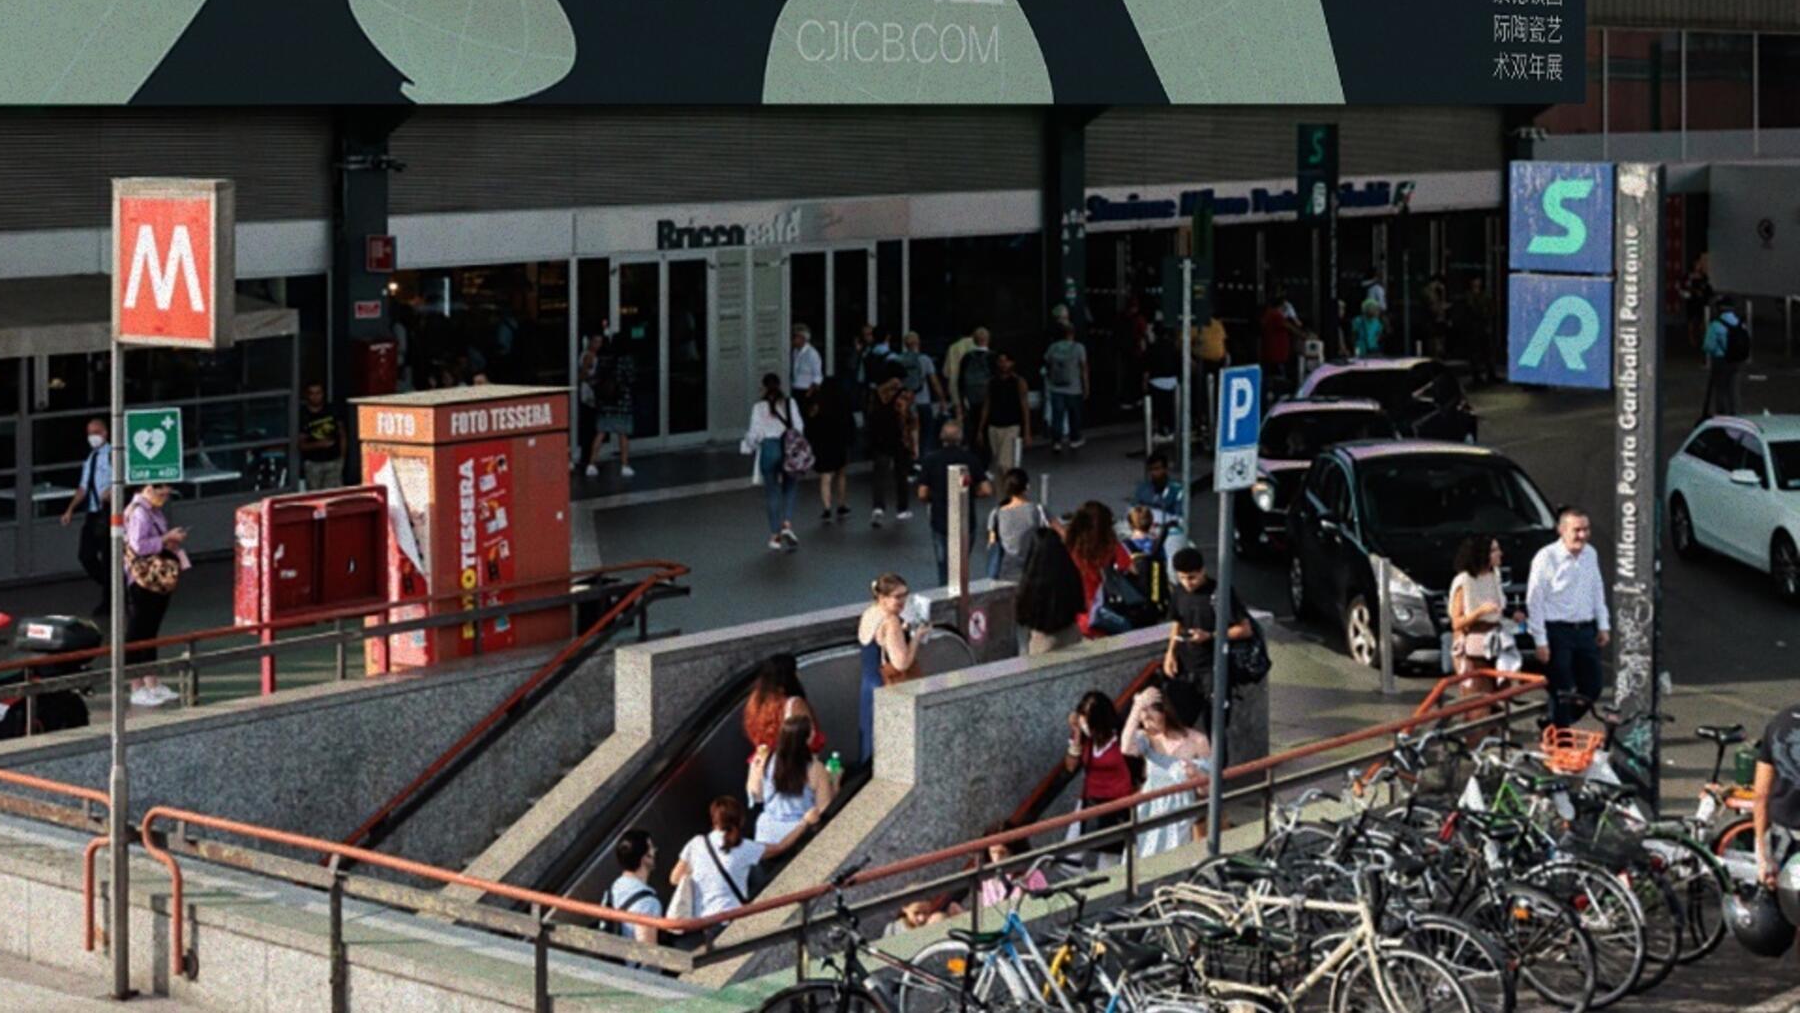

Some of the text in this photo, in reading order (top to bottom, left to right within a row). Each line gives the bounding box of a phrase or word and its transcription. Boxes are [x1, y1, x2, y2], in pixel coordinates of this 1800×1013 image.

[796, 18, 1000, 65] CJICB.COM
[1492, 13, 1563, 44] 际陶瓷艺
[1492, 51, 1563, 82] 术双年展
[1525, 178, 1595, 255] S
[123, 224, 205, 312] M
[1517, 294, 1600, 372] R
[1227, 376, 1254, 442] P
[1617, 327, 1639, 430] Garibaldi
[376, 411, 416, 437] FOTO
[451, 402, 553, 436] FOTO TESSERA
[1616, 436, 1638, 495] Porta
[1616, 501, 1637, 578] Milano
